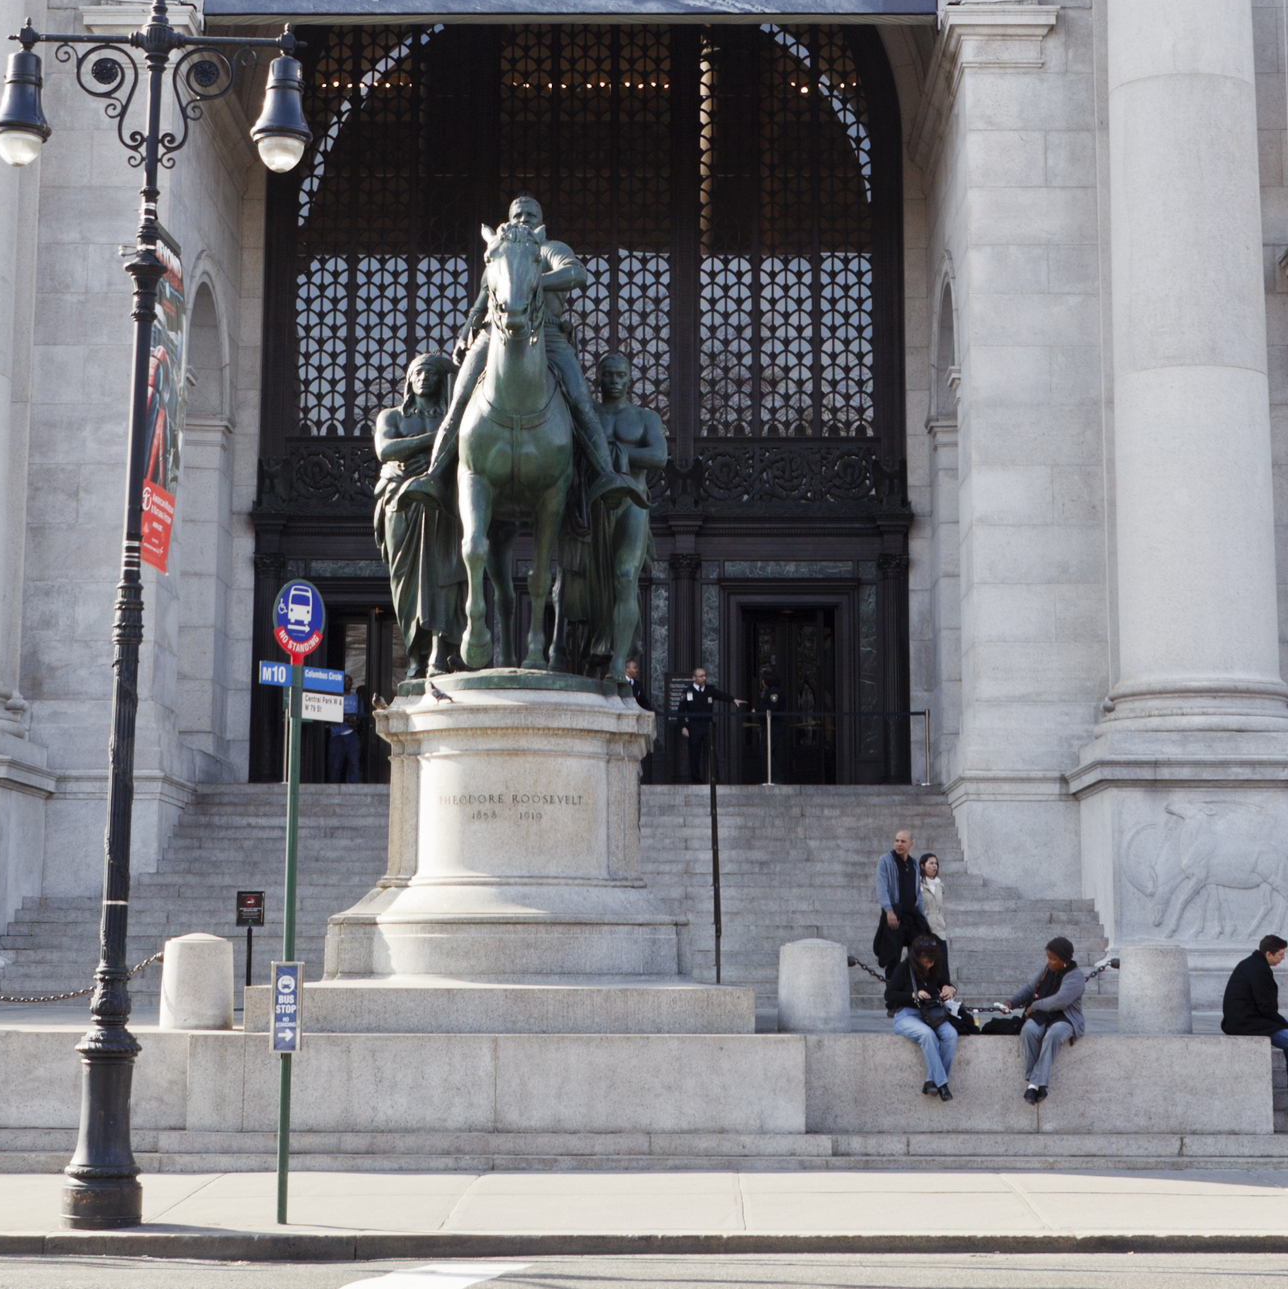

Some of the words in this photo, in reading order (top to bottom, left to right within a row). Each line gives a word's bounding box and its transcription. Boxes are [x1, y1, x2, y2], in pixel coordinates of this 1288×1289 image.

[279, 629, 289, 644] NO
[288, 635, 319, 652] STANDING
[262, 665, 286, 683] M10
[305, 669, 328, 680] Columbus
[329, 672, 342, 681] Circle
[305, 695, 322, 703] Central
[323, 696, 333, 704] Park
[439, 794, 504, 805] THEODORE
[512, 794, 583, 805] ROOSEVELT
[278, 995, 295, 1004] BUS
[275, 1004, 297, 1014] STOP
